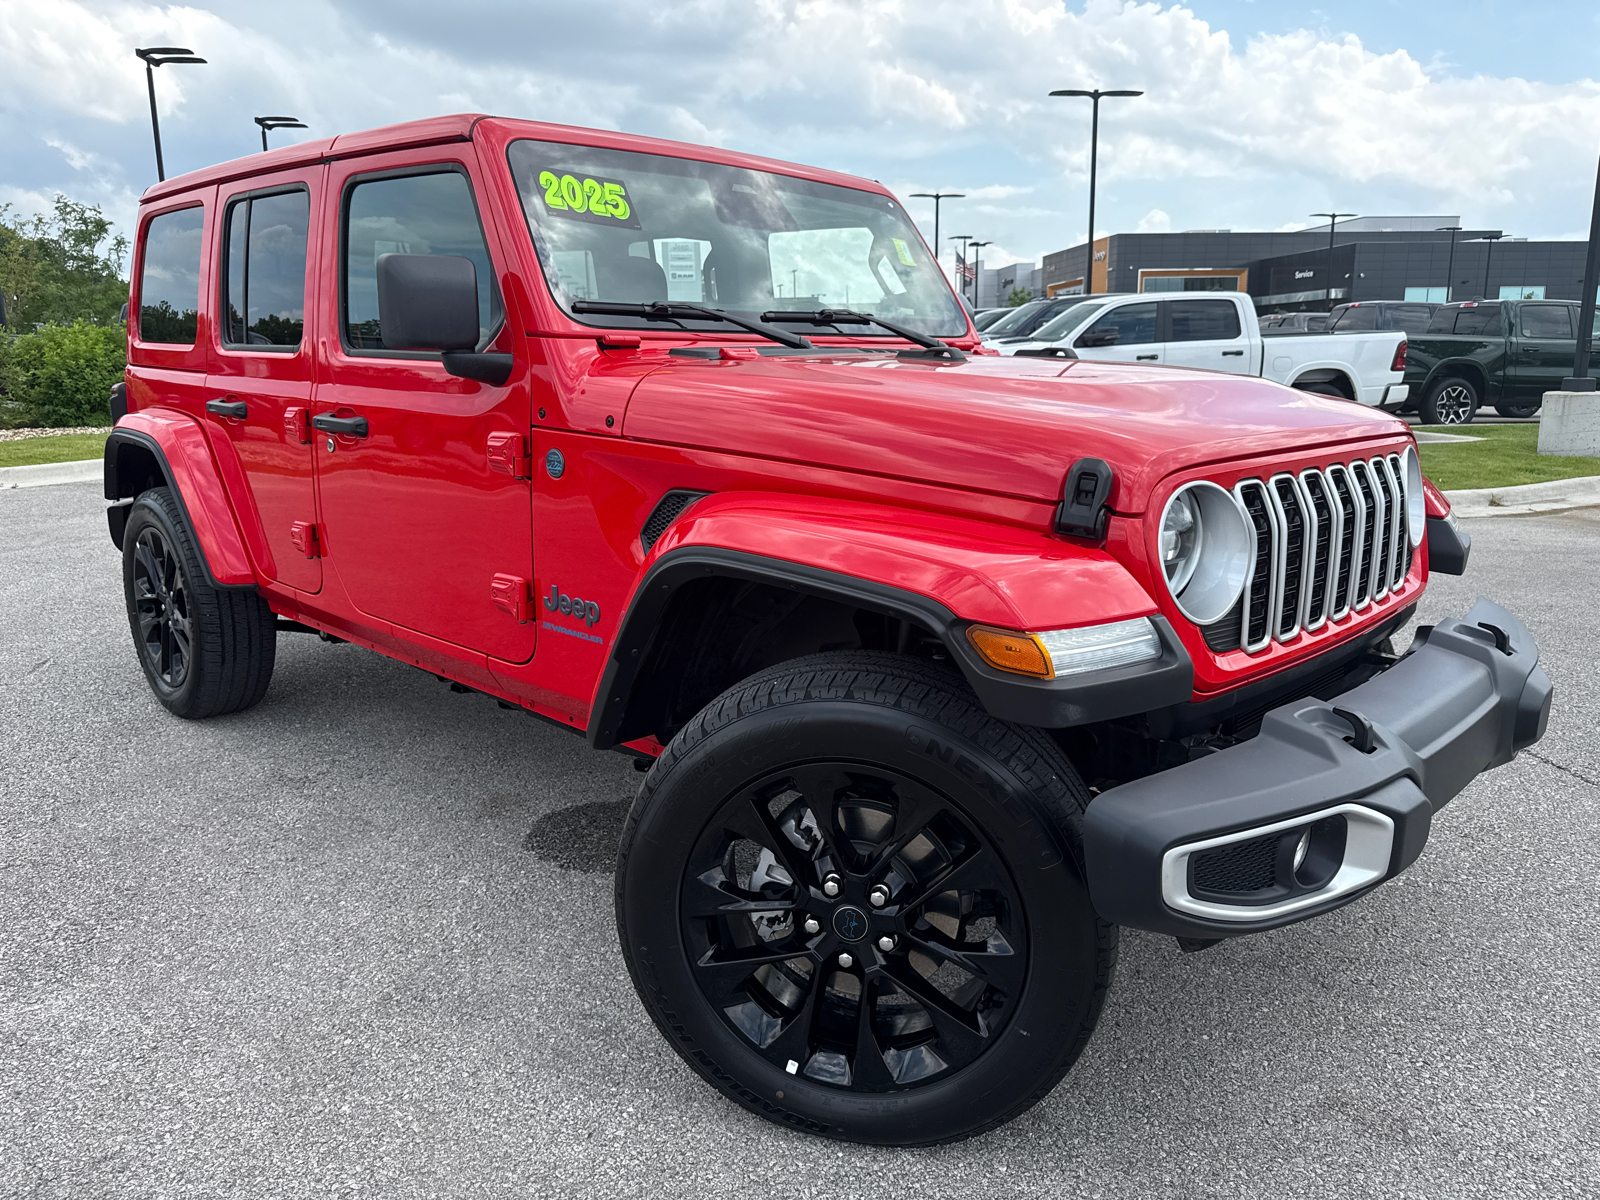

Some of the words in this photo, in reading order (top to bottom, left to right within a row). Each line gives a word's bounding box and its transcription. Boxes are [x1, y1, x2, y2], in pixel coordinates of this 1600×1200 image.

[539, 170, 631, 220] 2025
[1294, 269, 1314, 279] Service
[543, 584, 600, 628] Jeep
[551, 623, 604, 645] WRANGLER
[923, 738, 1048, 850] NEXEN
[690, 1048, 832, 1135] ROADIAN
